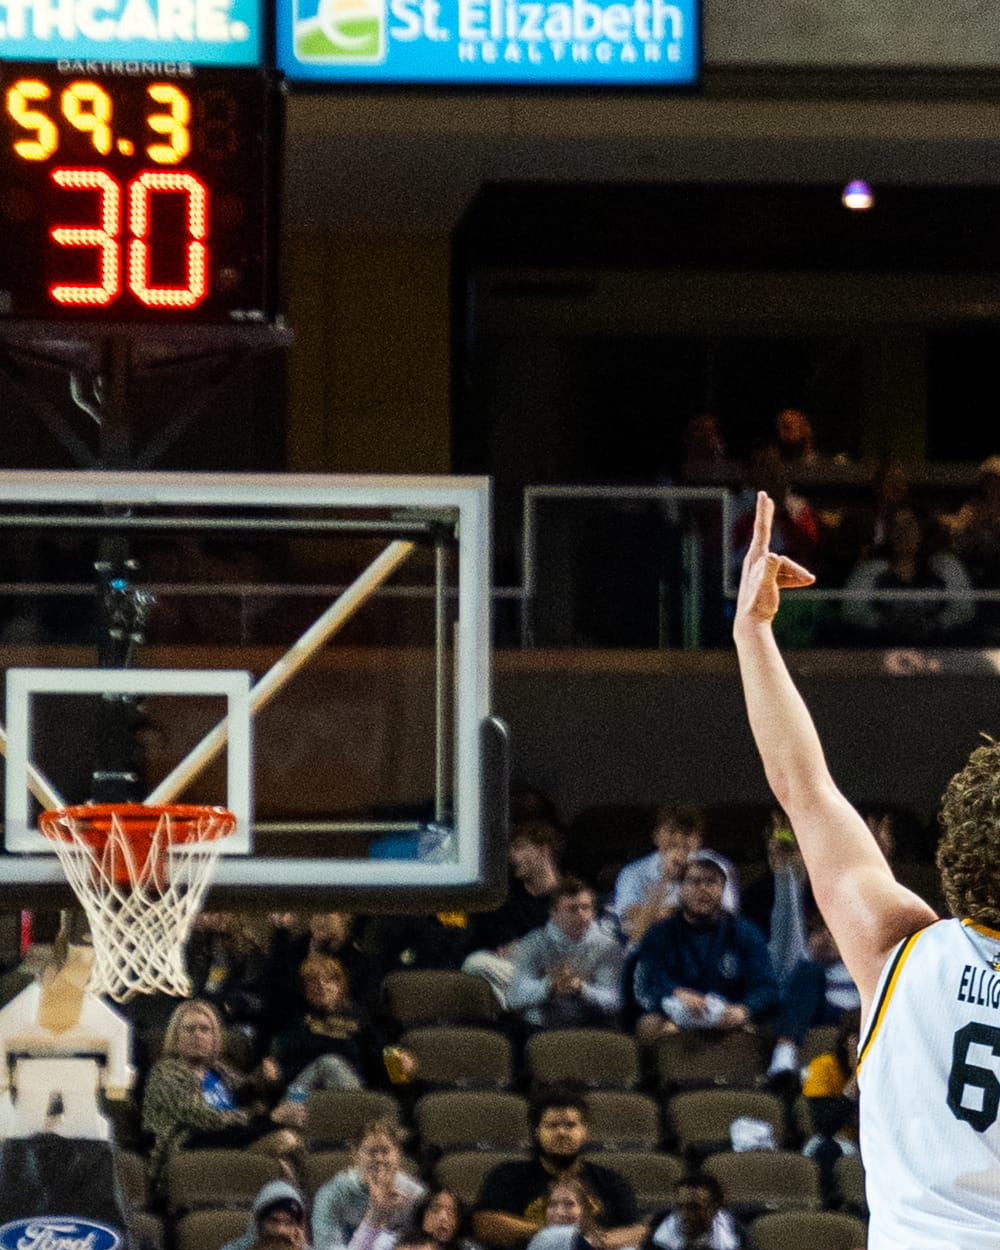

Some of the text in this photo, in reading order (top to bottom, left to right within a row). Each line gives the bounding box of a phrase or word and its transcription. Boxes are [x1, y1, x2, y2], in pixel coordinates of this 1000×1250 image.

[0, 0, 249, 41] THCARE.
[389, 0, 683, 42] St. Elizabeth
[57, 59, 194, 77] DAKTRONICS
[458, 41, 682, 63] HEALTHCARE
[7, 80, 191, 164] 59.3
[52, 169, 208, 307] 30
